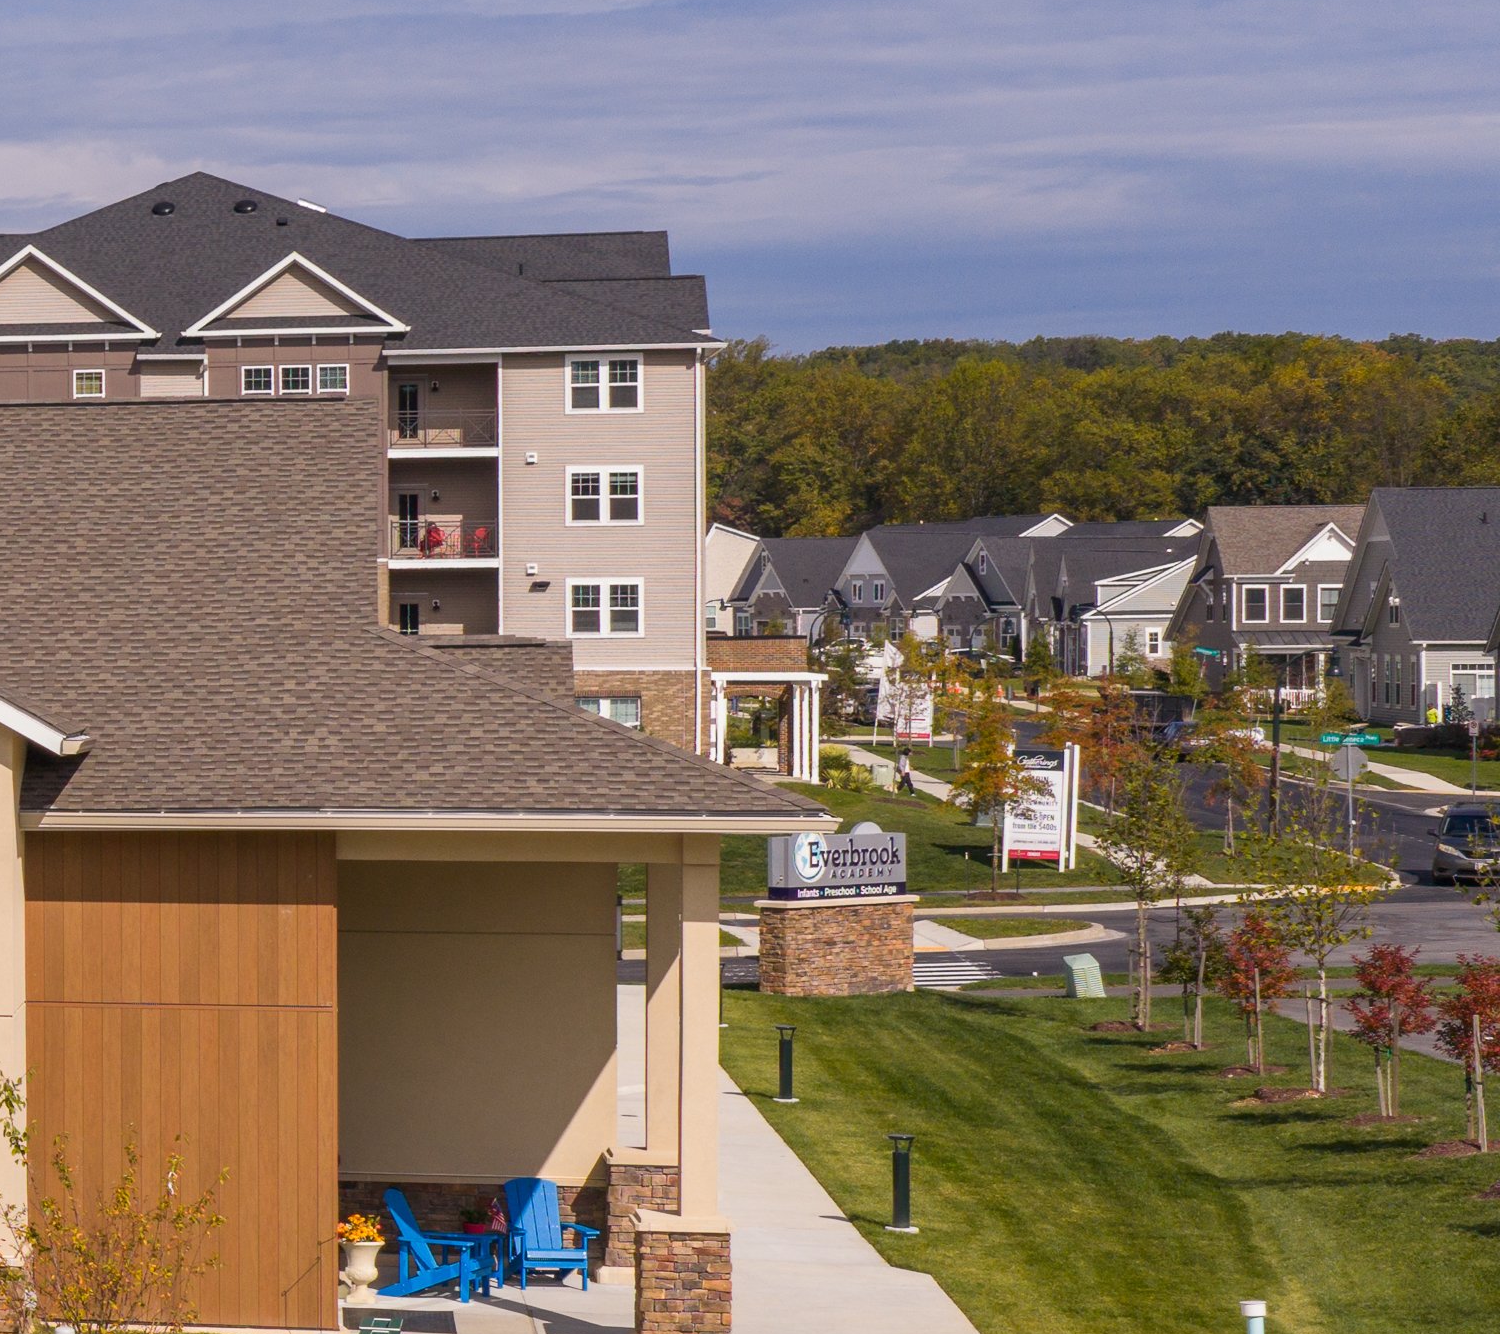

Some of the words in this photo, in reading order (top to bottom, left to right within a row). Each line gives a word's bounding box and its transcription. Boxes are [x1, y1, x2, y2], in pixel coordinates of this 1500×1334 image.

[1322, 735, 1340, 743] Little
[807, 837, 901, 868] Everbrook
[830, 868, 893, 879] ACADEMY
[798, 889, 820, 898] Infants
[824, 886, 856, 897] Preschool
[860, 885, 883, 895] School
[883, 885, 897, 895] Age
